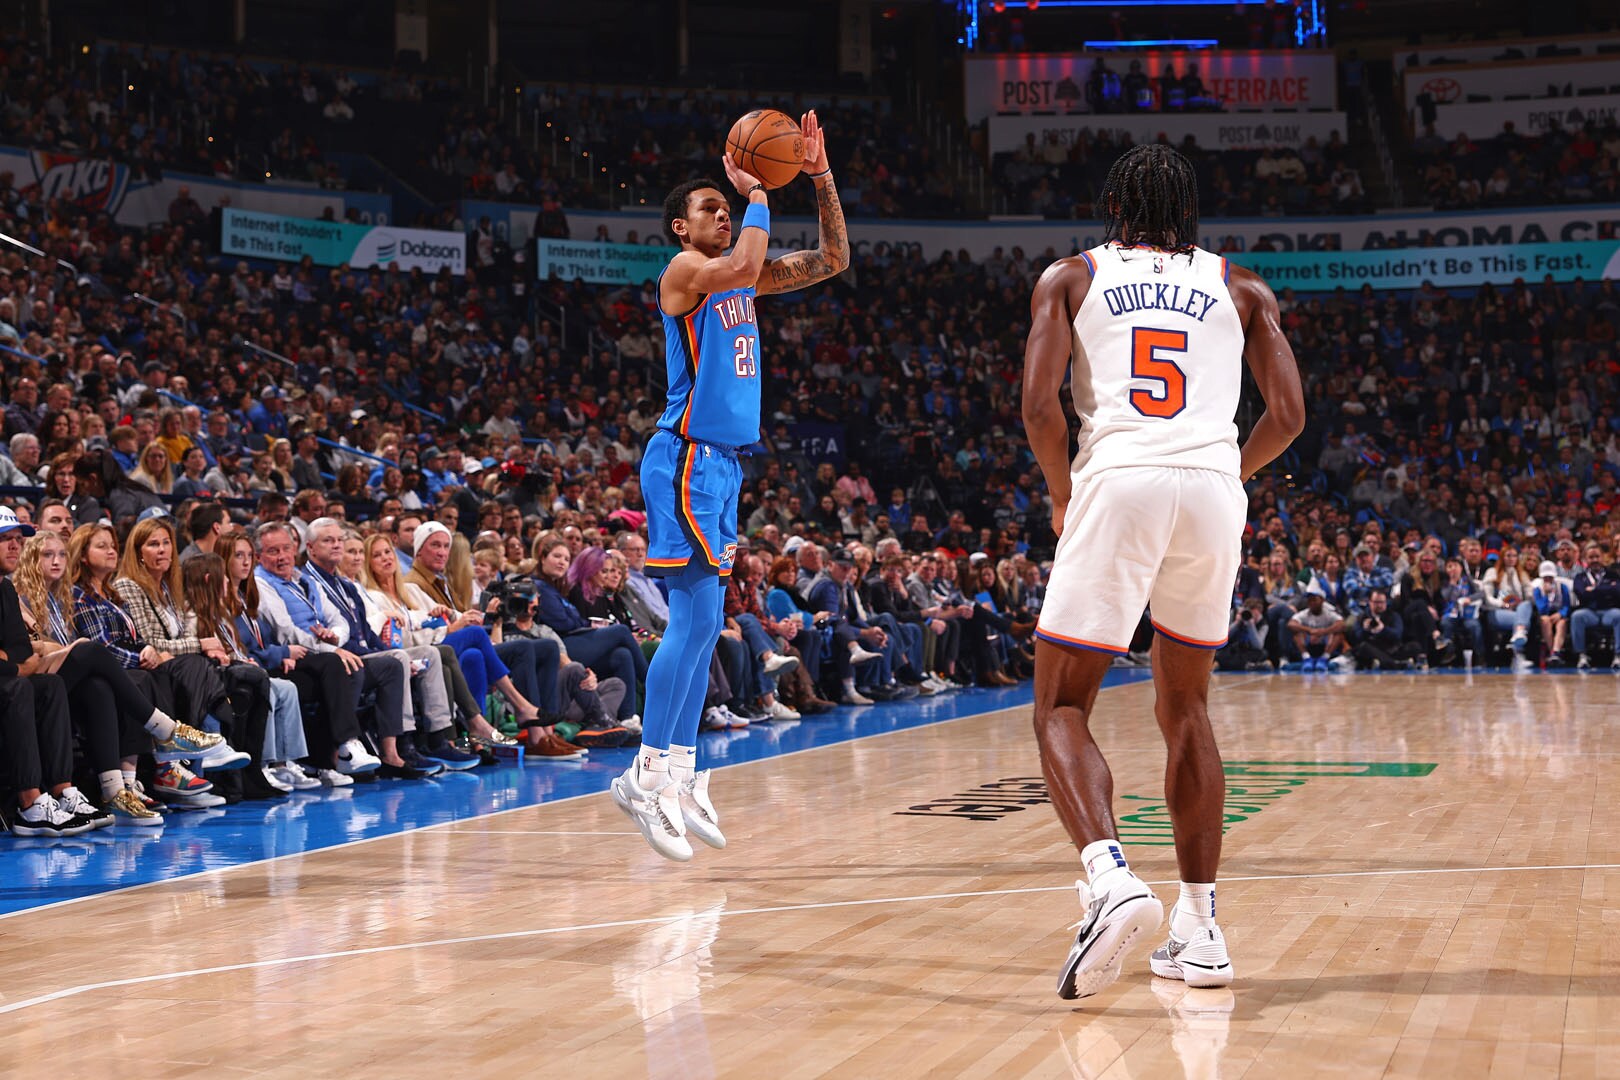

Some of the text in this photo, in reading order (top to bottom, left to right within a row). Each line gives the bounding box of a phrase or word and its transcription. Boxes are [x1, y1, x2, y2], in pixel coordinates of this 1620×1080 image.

[1003, 77, 1310, 105] POST TERRACE
[1219, 126, 1301, 143] POST OAK
[230, 214, 342, 241] Internet Shouldn't
[230, 234, 247, 249] Be
[250, 237, 275, 252] This
[400, 239, 461, 259] Dobson
[547, 243, 669, 265] Internet Shouldn't
[548, 262, 565, 276] Be
[568, 264, 595, 278] This
[771, 265, 797, 285] FEAR
[1253, 252, 1592, 280] ternet Shouldn't Be This Fast.
[1103, 282, 1219, 323] QUICKLEY
[1129, 326, 1188, 420] 5
